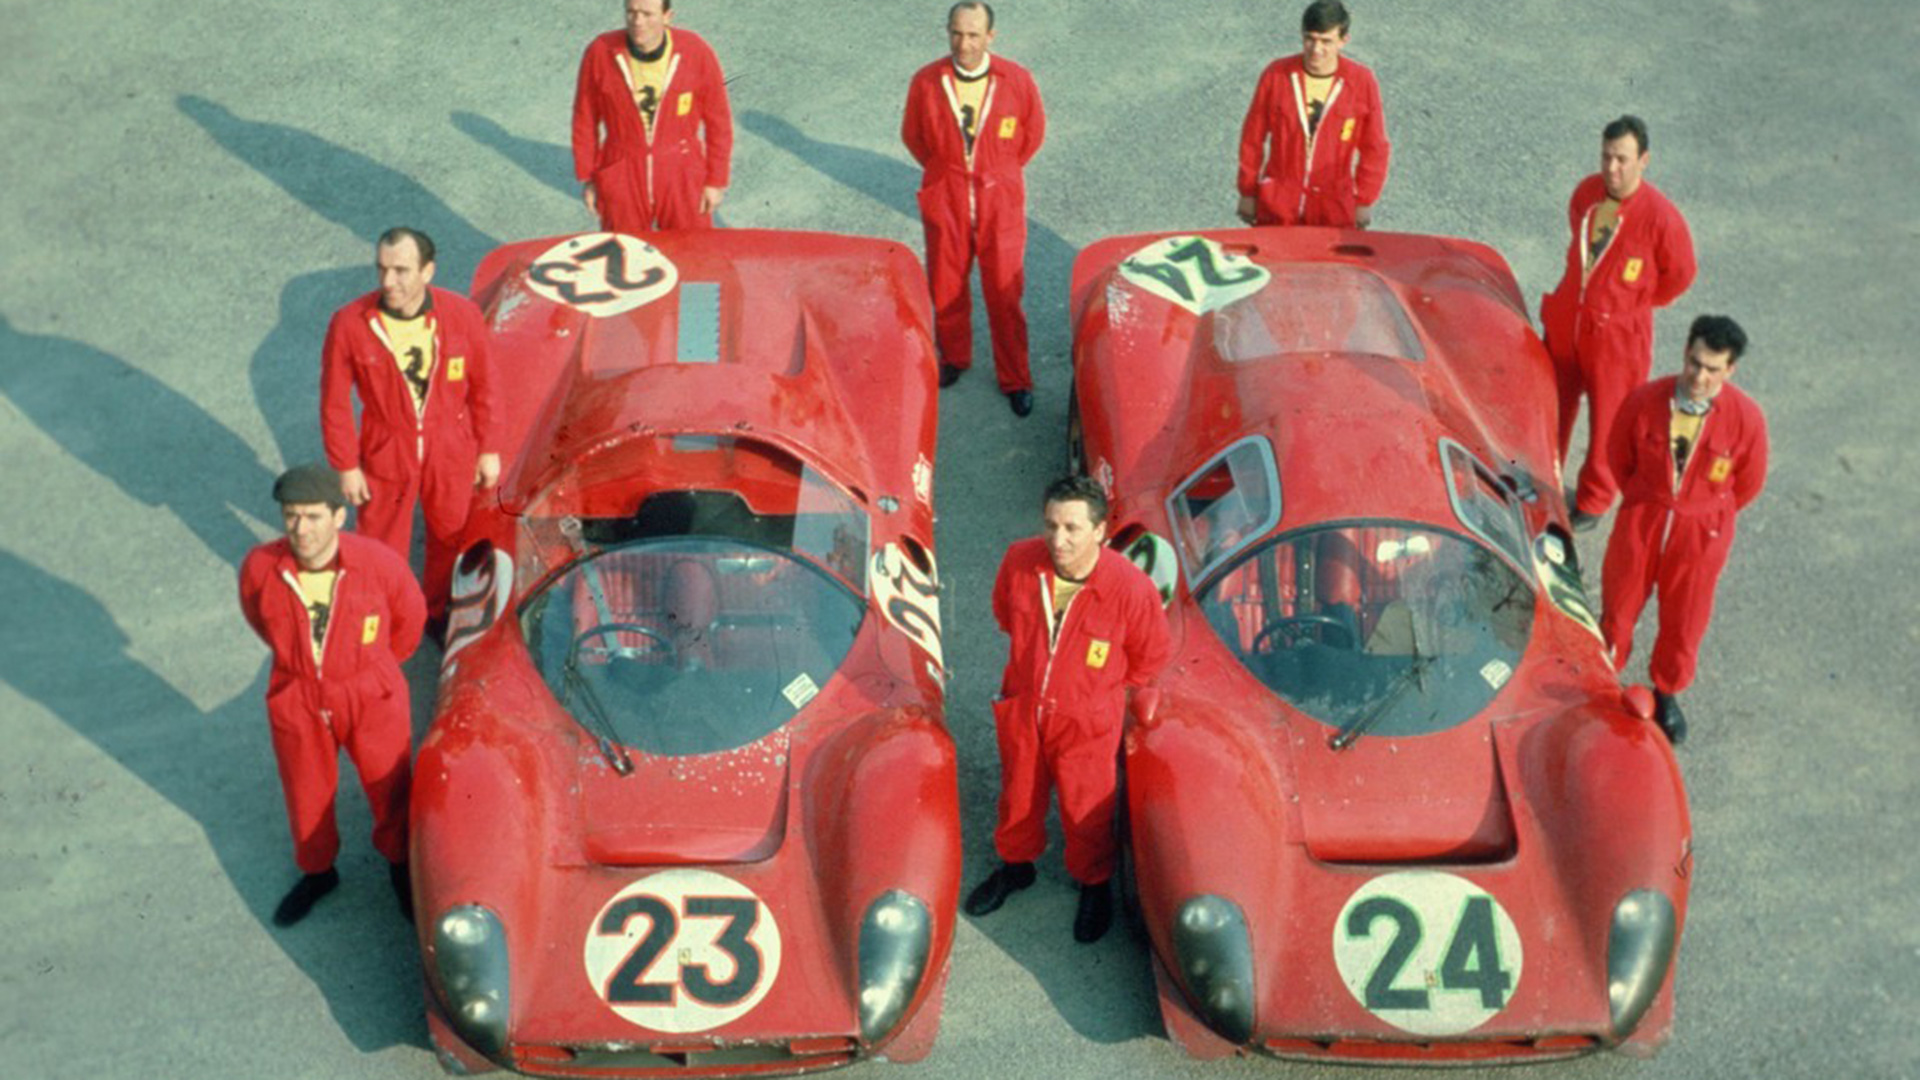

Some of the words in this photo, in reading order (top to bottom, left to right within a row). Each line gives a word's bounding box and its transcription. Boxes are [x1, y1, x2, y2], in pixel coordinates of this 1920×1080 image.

[528, 238, 667, 304] 23
[1122, 238, 1263, 302] 24
[597, 893, 764, 1008] 23
[1347, 895, 1511, 1010] 24
